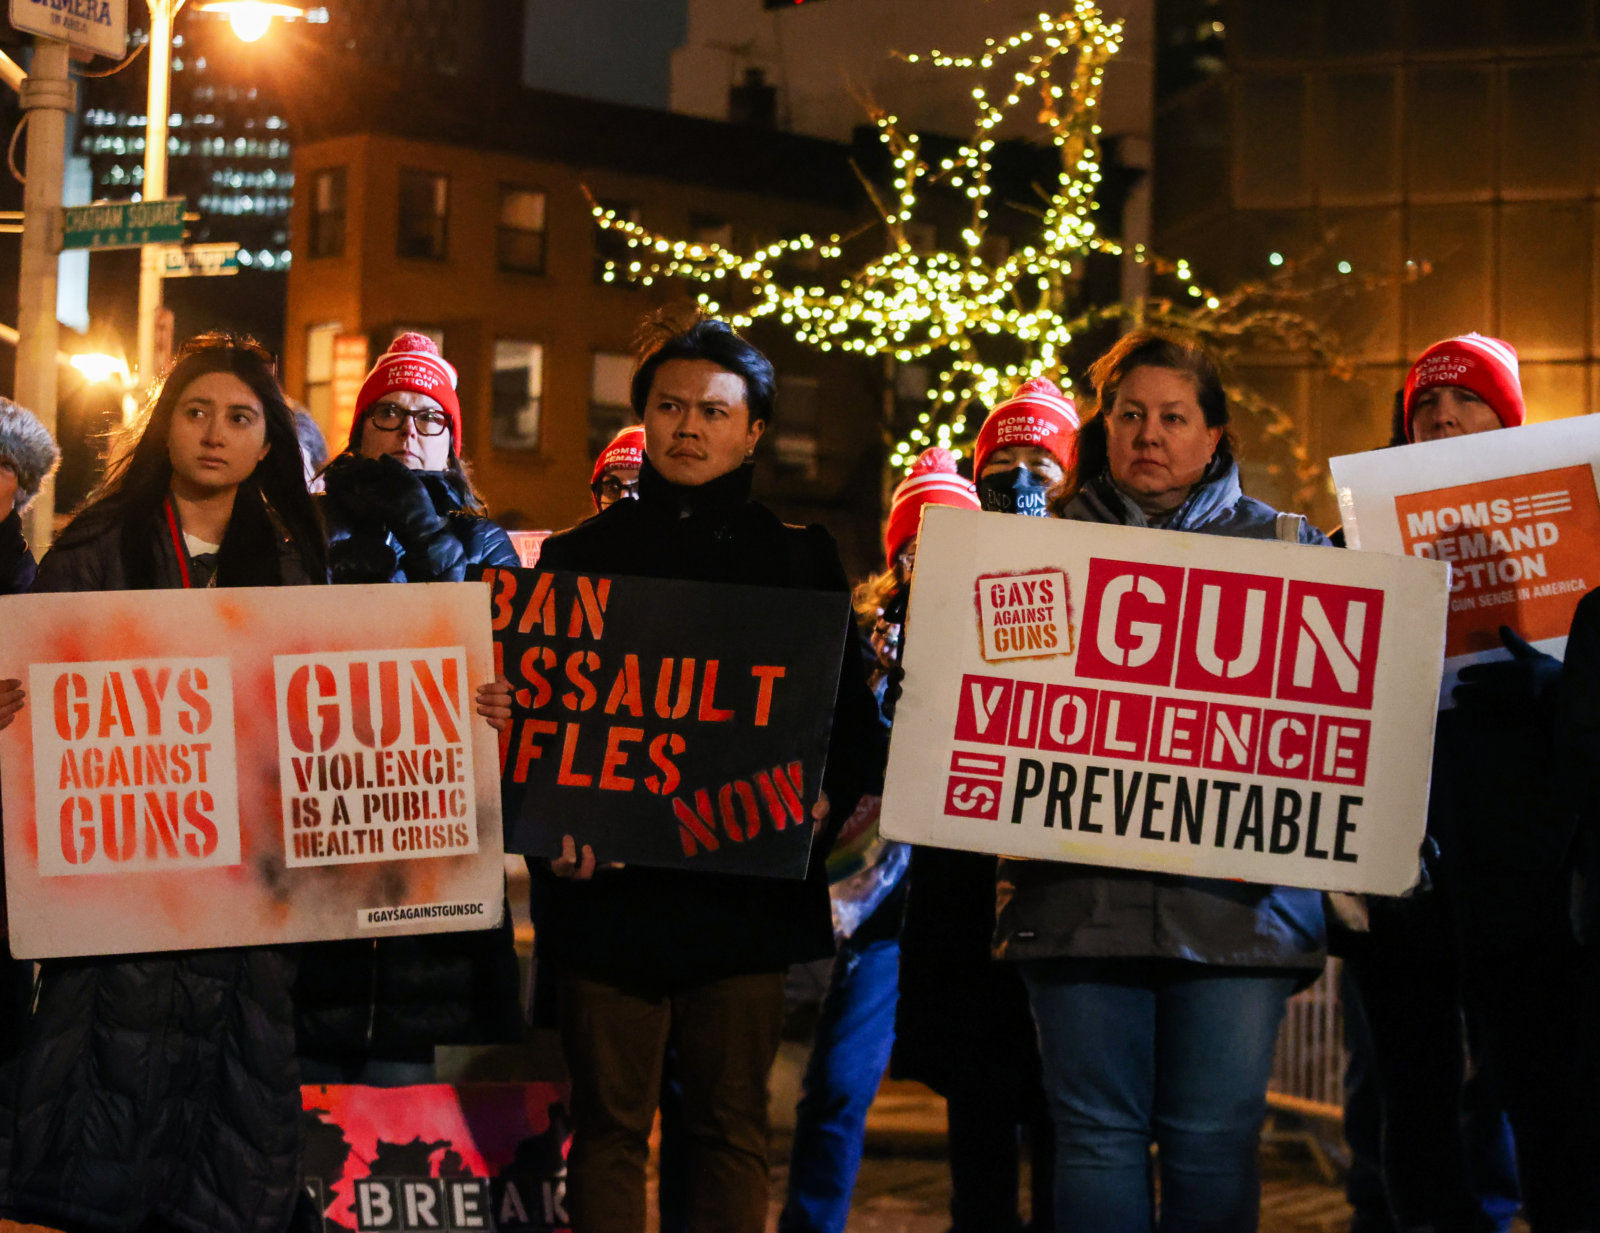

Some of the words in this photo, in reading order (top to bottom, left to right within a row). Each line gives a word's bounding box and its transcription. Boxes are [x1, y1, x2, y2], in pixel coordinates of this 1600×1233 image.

[31, 0, 112, 26] MERA
[127, 201, 180, 229] SQUARE
[996, 433, 1042, 443] ACTION
[998, 416, 1035, 427] MOMS
[998, 425, 1050, 436] DEMAND
[606, 447, 637, 458] MOMS
[1017, 491, 1047, 508] GUN
[1406, 499, 1513, 538] MOMS
[1413, 522, 1559, 562] DEMAND
[1450, 553, 1547, 593] CTION
[481, 568, 612, 640] BAN
[991, 579, 1054, 609] GAYS
[1451, 596, 1476, 612] GUN
[1480, 589, 1516, 608] SENSE
[1518, 587, 1530, 600] IN
[1533, 578, 1587, 598] AMERICA
[994, 606, 1054, 626] AGAINST
[1096, 573, 1368, 694] GUN
[994, 623, 1058, 653] GUNS
[53, 667, 212, 741] GAYS
[286, 658, 462, 753] GUN
[970, 682, 1361, 779] VIOLENCE
[59, 743, 212, 790] AGAINST
[291, 747, 464, 792] VIOLENCE
[951, 755, 1001, 814] IS
[60, 789, 218, 865] GUNS
[292, 797, 321, 829] IS
[331, 795, 351, 826] A
[363, 788, 467, 824] PUBLIC
[672, 760, 805, 858] NOW
[1011, 758, 1364, 864] PREVENTABLE
[293, 828, 384, 859] HEALTH
[392, 822, 469, 852] CRISIS
[368, 903, 484, 923] #GAYSAGAINSTGUNSDC
[358, 1180, 570, 1227] BREAK
